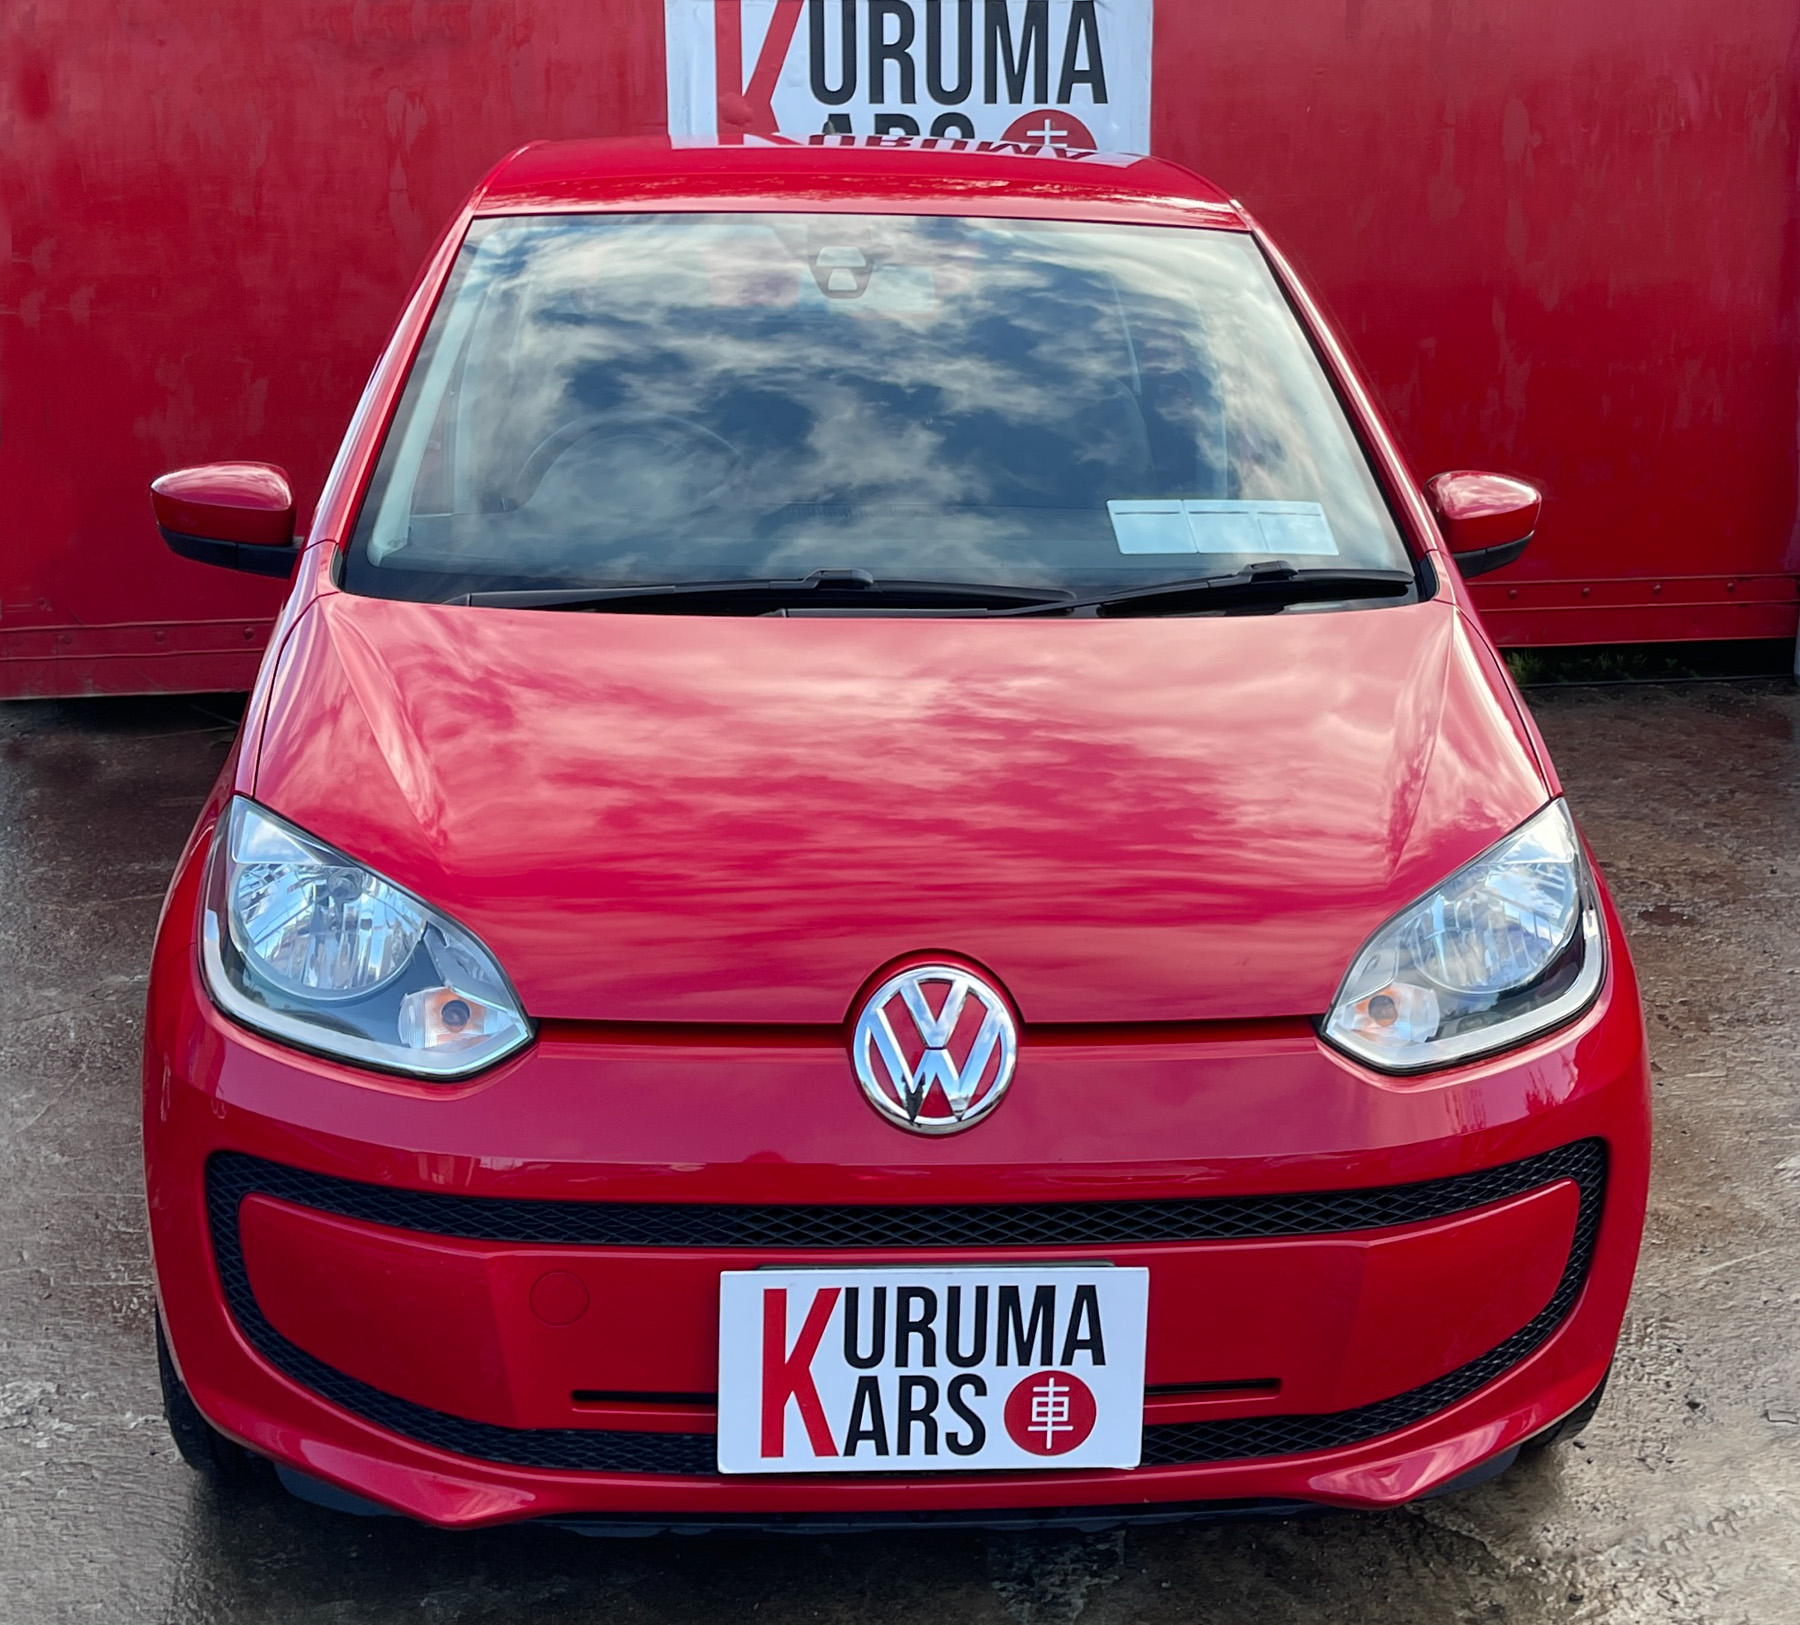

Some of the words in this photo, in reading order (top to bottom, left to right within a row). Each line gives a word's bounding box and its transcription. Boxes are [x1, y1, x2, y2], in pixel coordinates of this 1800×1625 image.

[714, 0, 1108, 135] KURUMA
[761, 1285, 1106, 1458] KURUMA
[1027, 1377, 1074, 1450] 車
